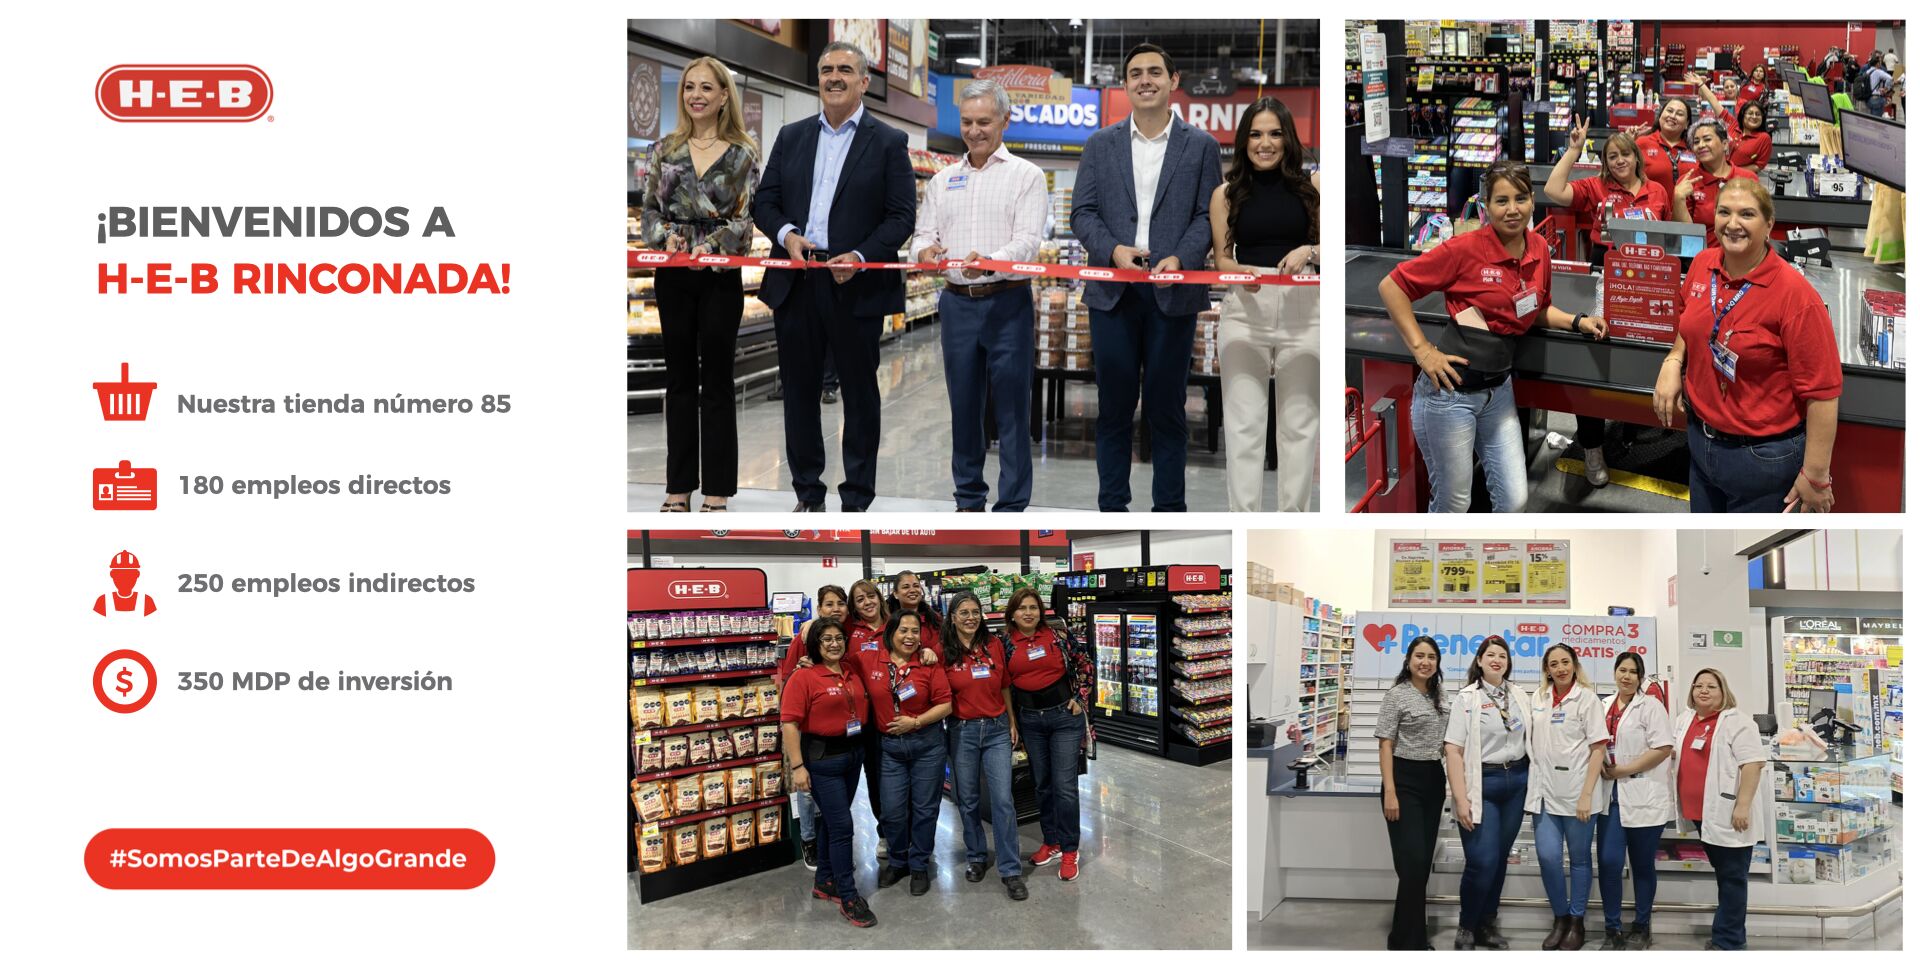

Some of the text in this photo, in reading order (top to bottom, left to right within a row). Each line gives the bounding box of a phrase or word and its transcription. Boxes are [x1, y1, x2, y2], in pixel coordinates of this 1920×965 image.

[1009, 103, 1098, 127] SCADOS
[1562, 624, 1639, 639] COMPRA 3
[1402, 623, 1550, 657] Benetar
[1562, 636, 1626, 645] medicamentos
[1572, 646, 1614, 658] RATIS
